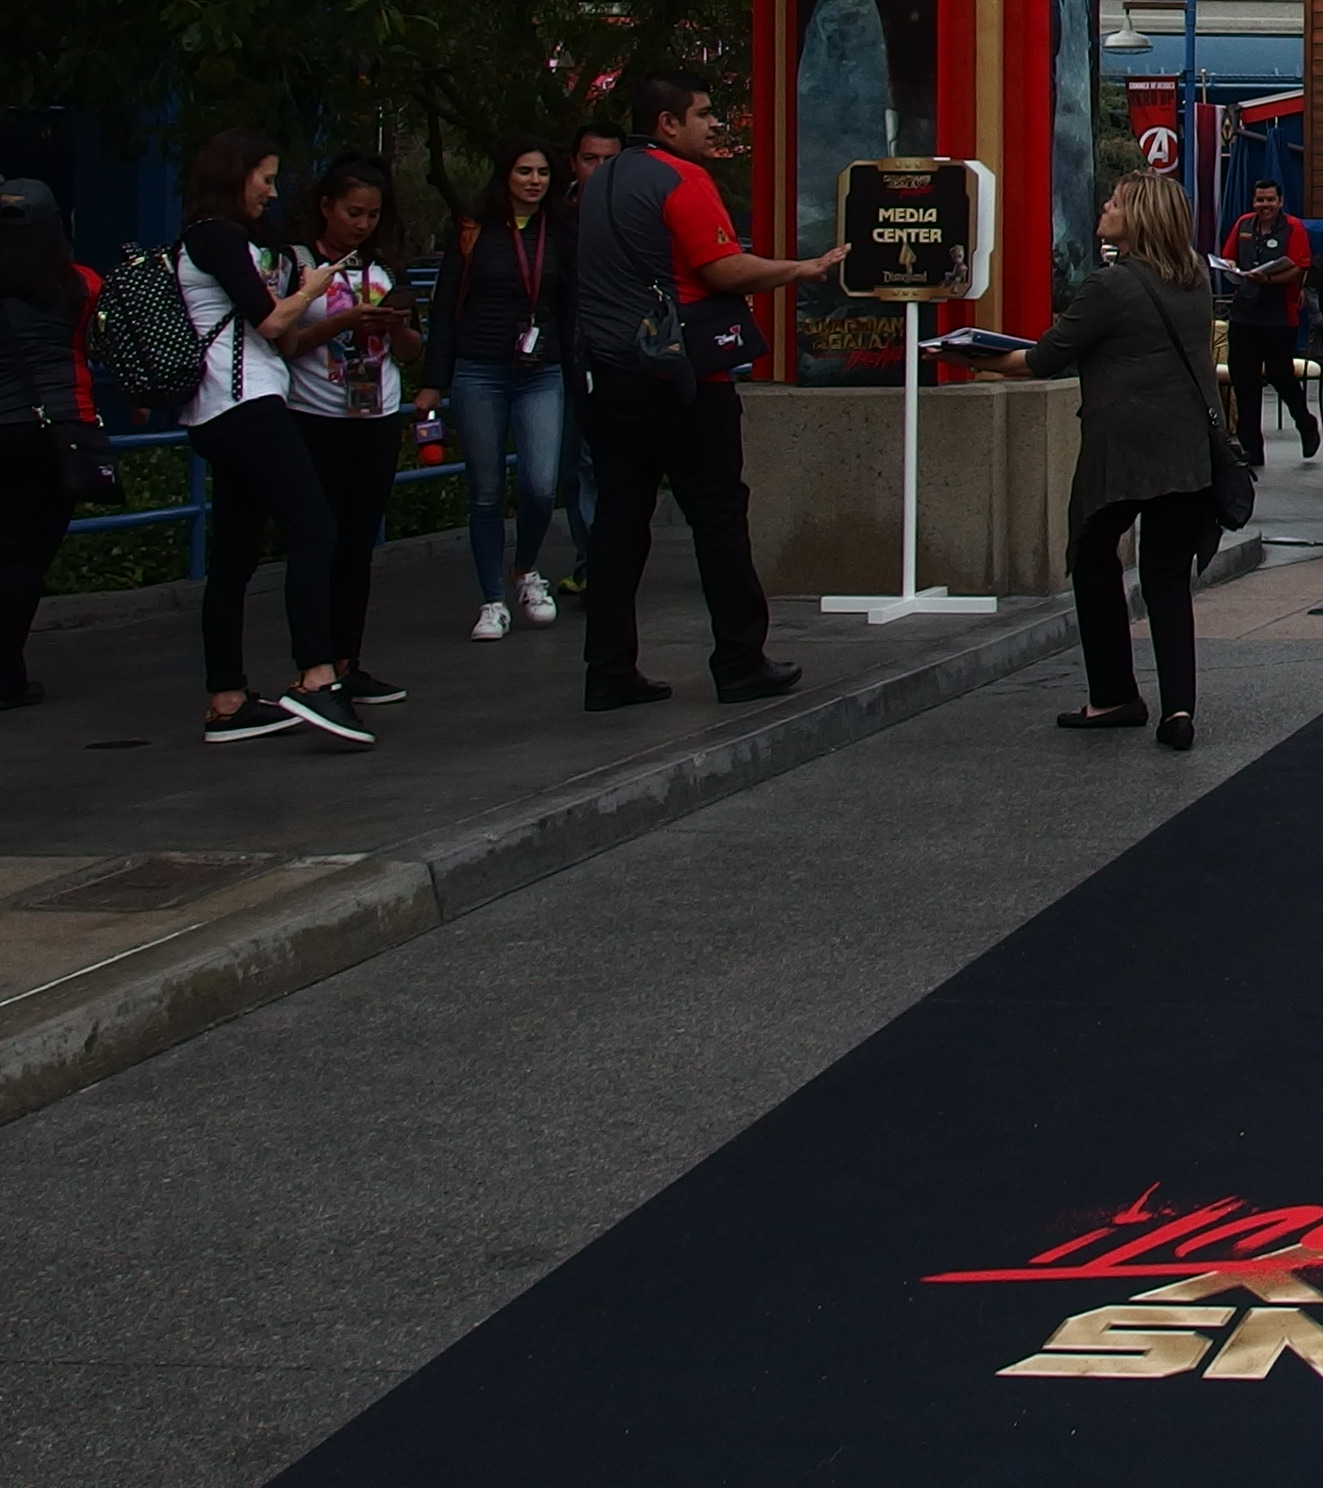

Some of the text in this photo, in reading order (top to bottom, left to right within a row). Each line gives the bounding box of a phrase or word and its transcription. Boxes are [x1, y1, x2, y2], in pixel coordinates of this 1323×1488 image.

[878, 207, 938, 223] MEDIA
[872, 228, 943, 243] CENTER
[803, 315, 905, 335] GUARDIAN
